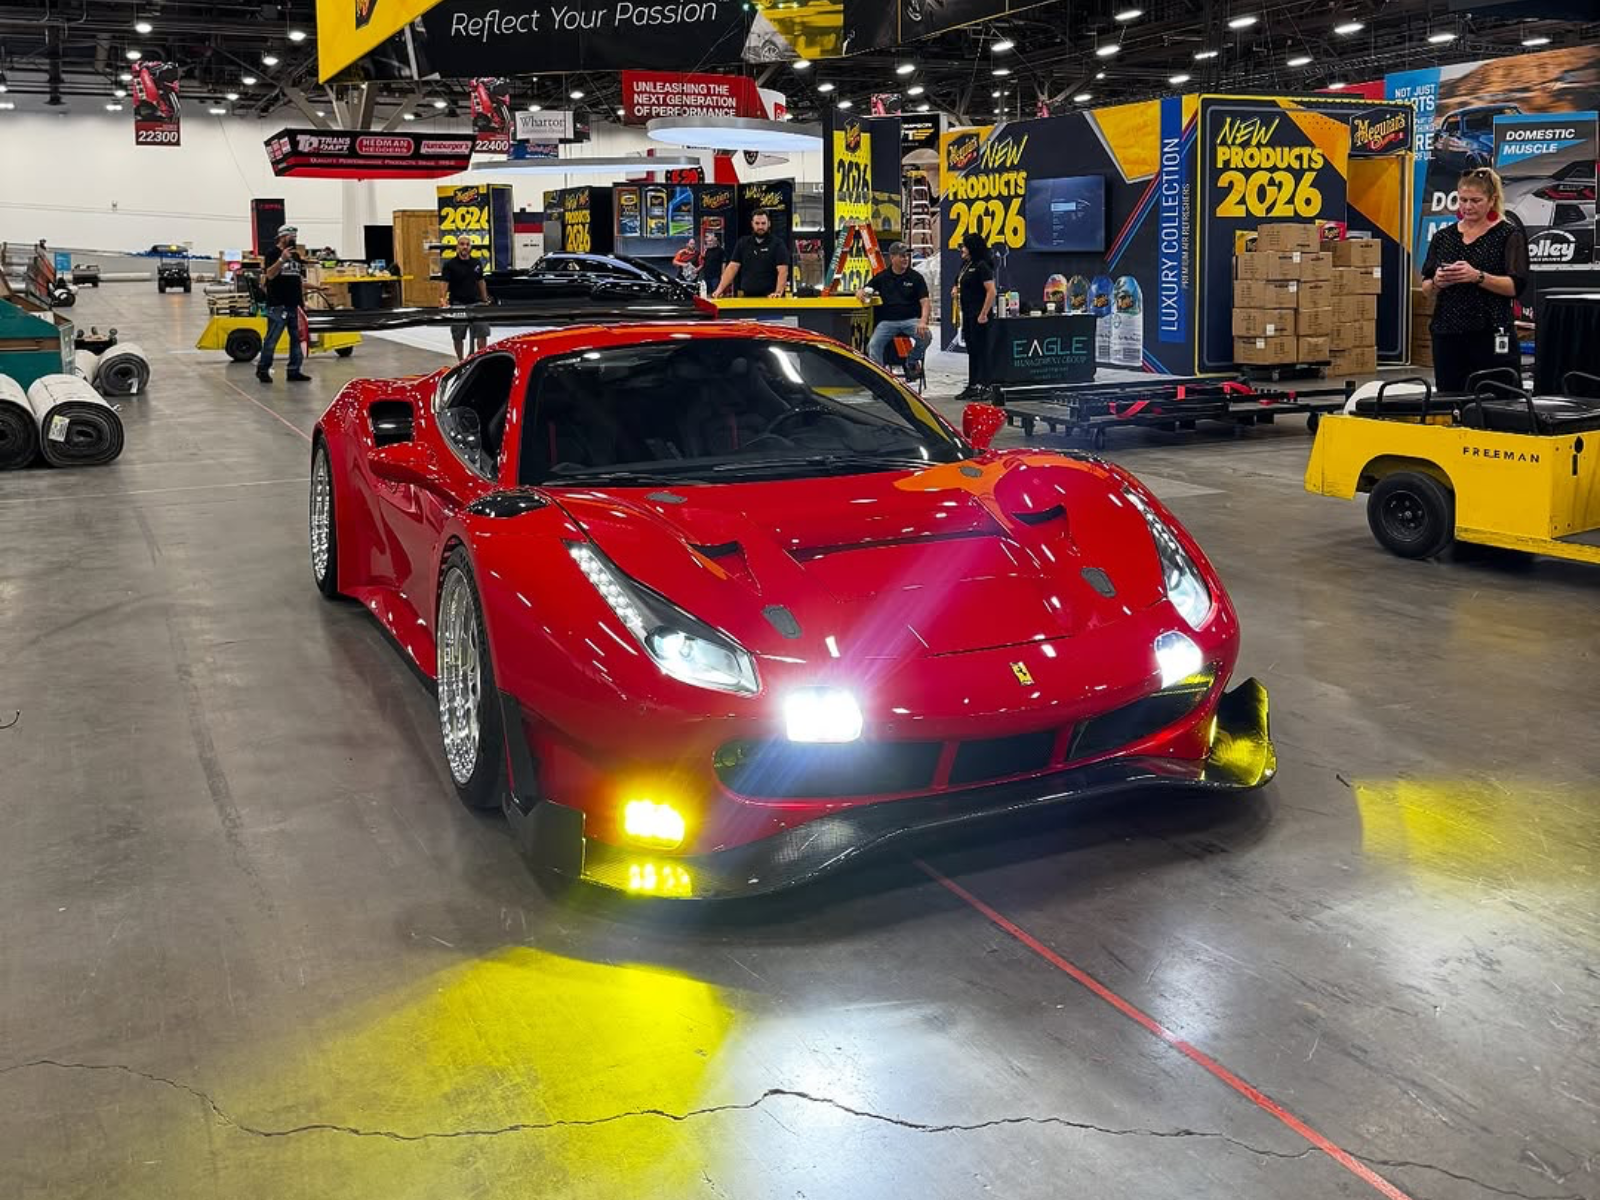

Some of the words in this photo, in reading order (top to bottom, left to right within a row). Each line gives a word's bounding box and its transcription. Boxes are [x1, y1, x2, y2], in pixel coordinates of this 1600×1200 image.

[451, 9, 541, 43] Reflect
[550, 5, 608, 31] Your
[614, 0, 718, 27] Passion
[633, 81, 707, 94] UNLEASHING
[708, 84, 729, 96] THE
[1394, 87, 1411, 98] NOT
[1413, 84, 1435, 96] JUST
[633, 93, 664, 105] NEXT
[666, 95, 736, 107] GENERATION
[634, 105, 650, 117] OF
[651, 106, 736, 118] PERFORMANCE
[138, 131, 178, 142] 22300
[320, 137, 351, 145] TRANS
[1216, 117, 1280, 146] NEW
[1505, 128, 1575, 141] DOMESTIC
[362, 138, 408, 147] HEDMAN
[474, 140, 509, 151] 22400
[980, 133, 1029, 169] NEW
[1503, 143, 1558, 155] MUSCLE
[1216, 145, 1324, 169] PRODUCTS
[947, 171, 1028, 200] PRODUCTS
[1215, 170, 1323, 217] 2026
[1162, 138, 1181, 254] COLLECTION
[565, 209, 591, 224] PRODUCTS
[947, 197, 1027, 250] 2026
[566, 224, 591, 252] 2026
[1528, 239, 1576, 262] olley
[1160, 257, 1178, 331] LUXURY
[1012, 336, 1089, 358] EAGLE
[1462, 446, 1540, 463] FREEMAN
